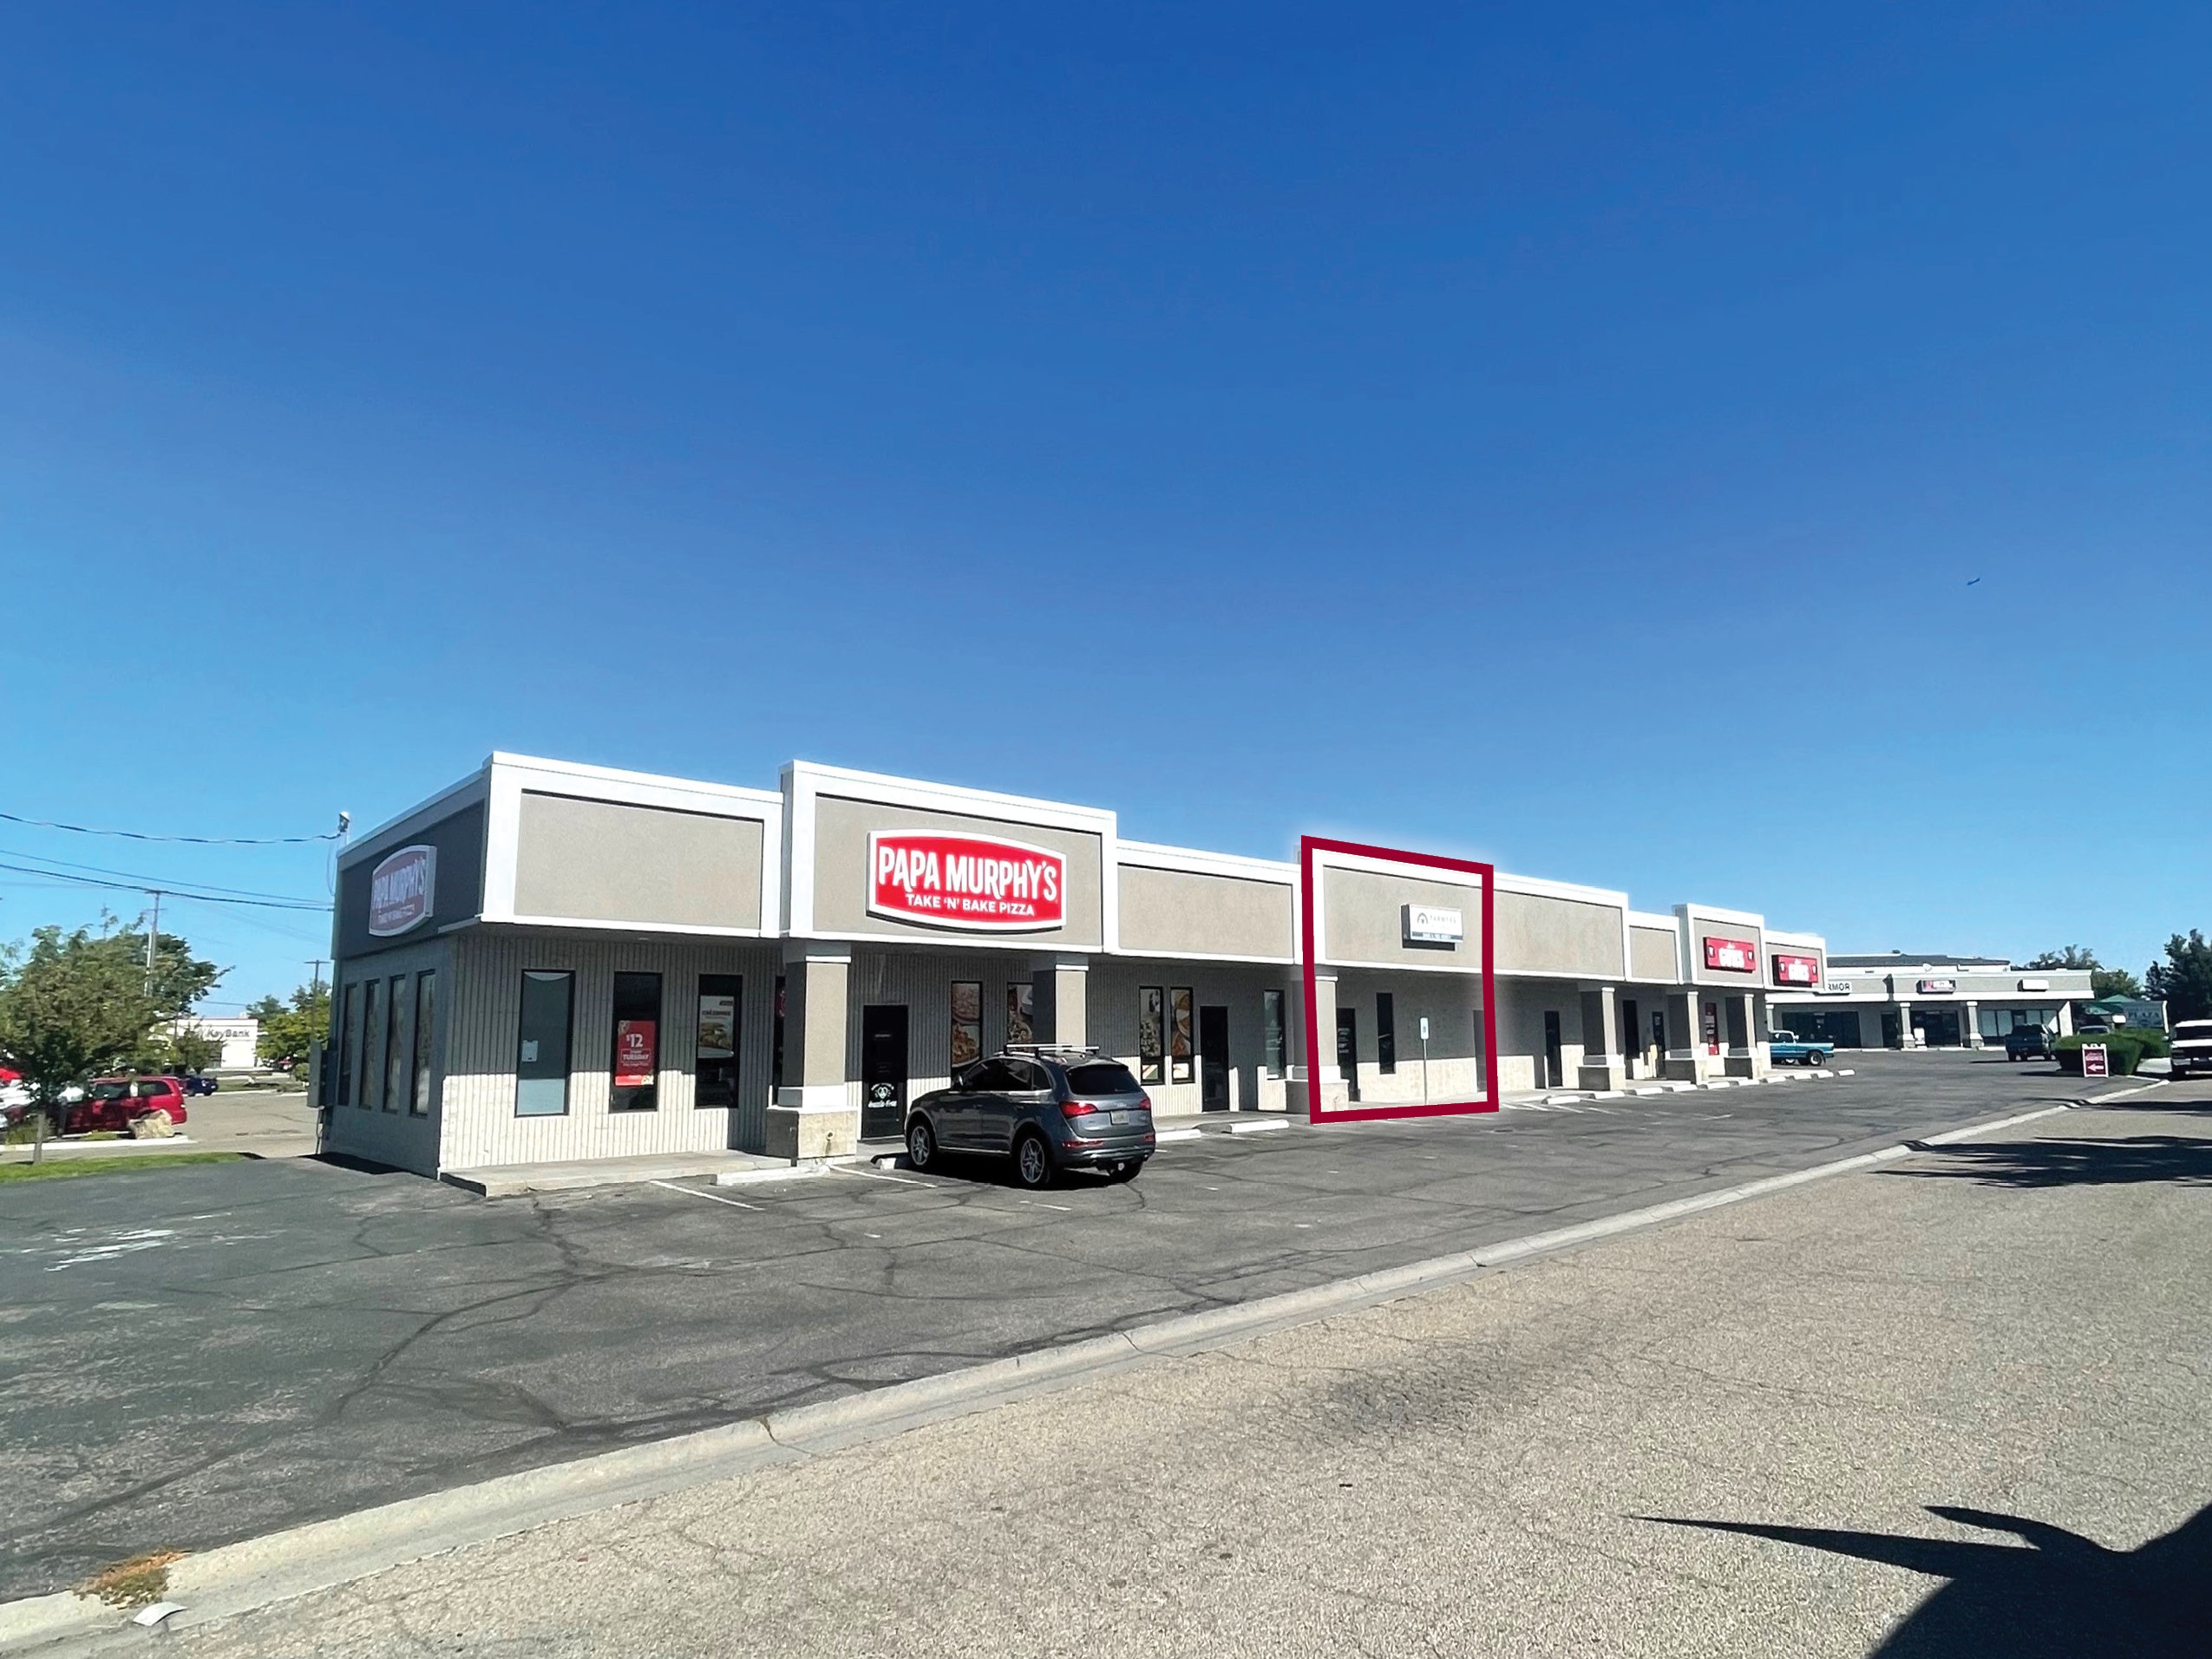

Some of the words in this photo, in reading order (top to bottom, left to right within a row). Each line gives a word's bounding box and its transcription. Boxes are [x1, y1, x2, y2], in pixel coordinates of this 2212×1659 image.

[879, 846, 940, 892] PAPA
[946, 854, 1057, 902] MURPHY'S
[906, 893, 940, 908] TAKE
[962, 898, 997, 913] BAKE
[998, 903, 1035, 917] PIZZA
